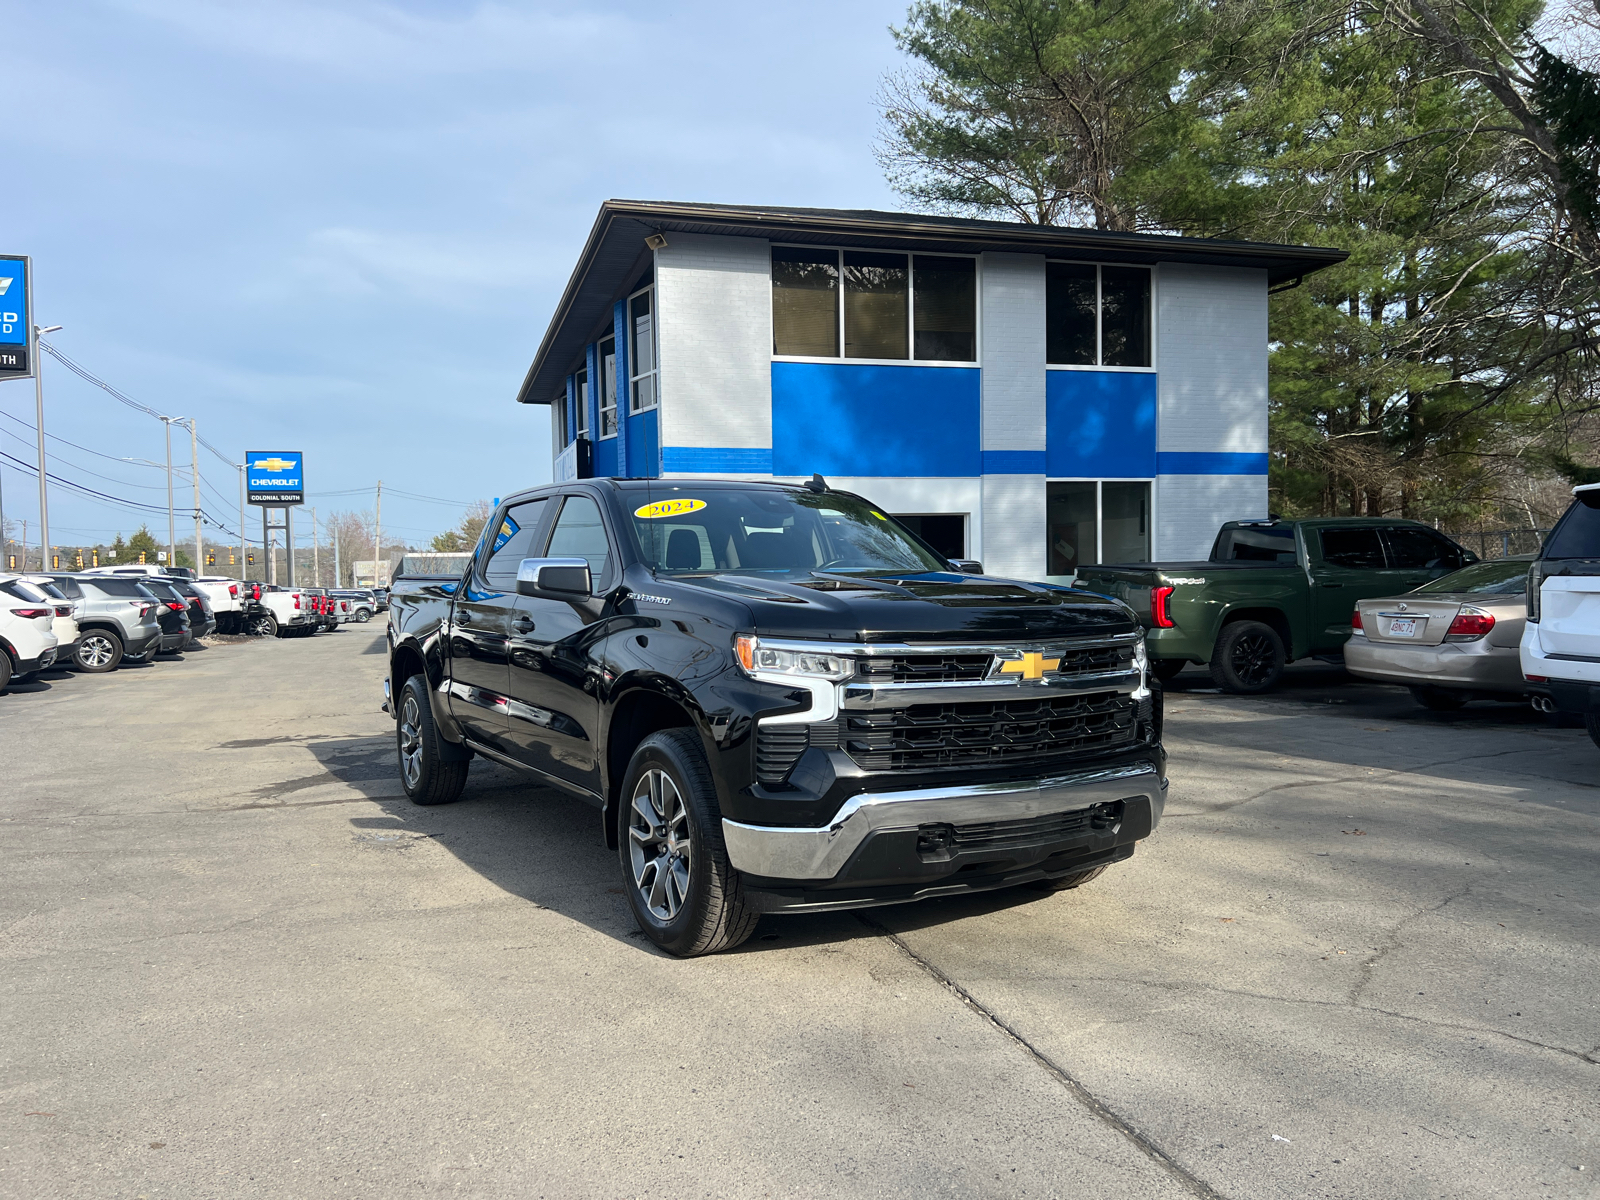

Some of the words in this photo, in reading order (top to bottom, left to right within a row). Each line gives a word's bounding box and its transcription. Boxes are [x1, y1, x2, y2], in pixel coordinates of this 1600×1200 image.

[0, 312, 18, 323] D
[0, 354, 16, 365] TH
[650, 500, 695, 516] 2024
